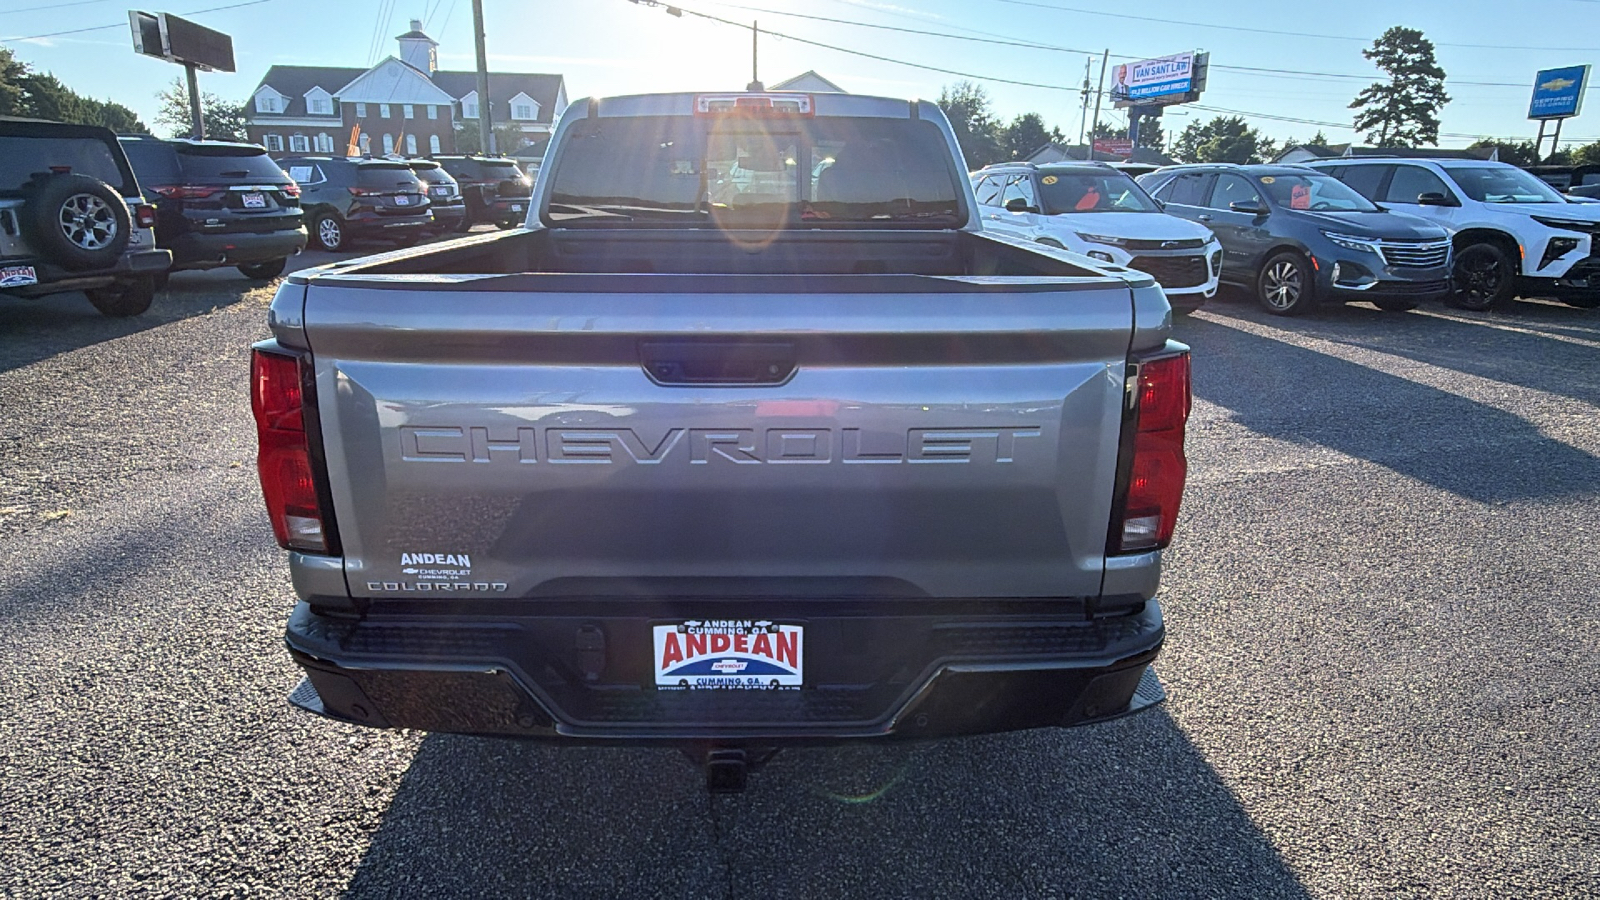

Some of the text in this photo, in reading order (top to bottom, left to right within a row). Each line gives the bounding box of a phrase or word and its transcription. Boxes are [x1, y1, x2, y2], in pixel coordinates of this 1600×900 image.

[1136, 67, 1150, 78] VAN
[1151, 63, 1171, 76] SANT
[1171, 61, 1187, 72] LAW
[1160, 84, 1170, 92] CAR
[1293, 188, 1308, 199] SALE
[399, 426, 1041, 464] CHEVROLET
[401, 553, 471, 568] ANDEAN
[366, 581, 509, 592] COLORADO
[703, 620, 752, 628] ANDEAN
[687, 627, 768, 635] CUMMING, GA
[662, 631, 798, 670] ANDEAN
[696, 677, 745, 686] CUMMING,
